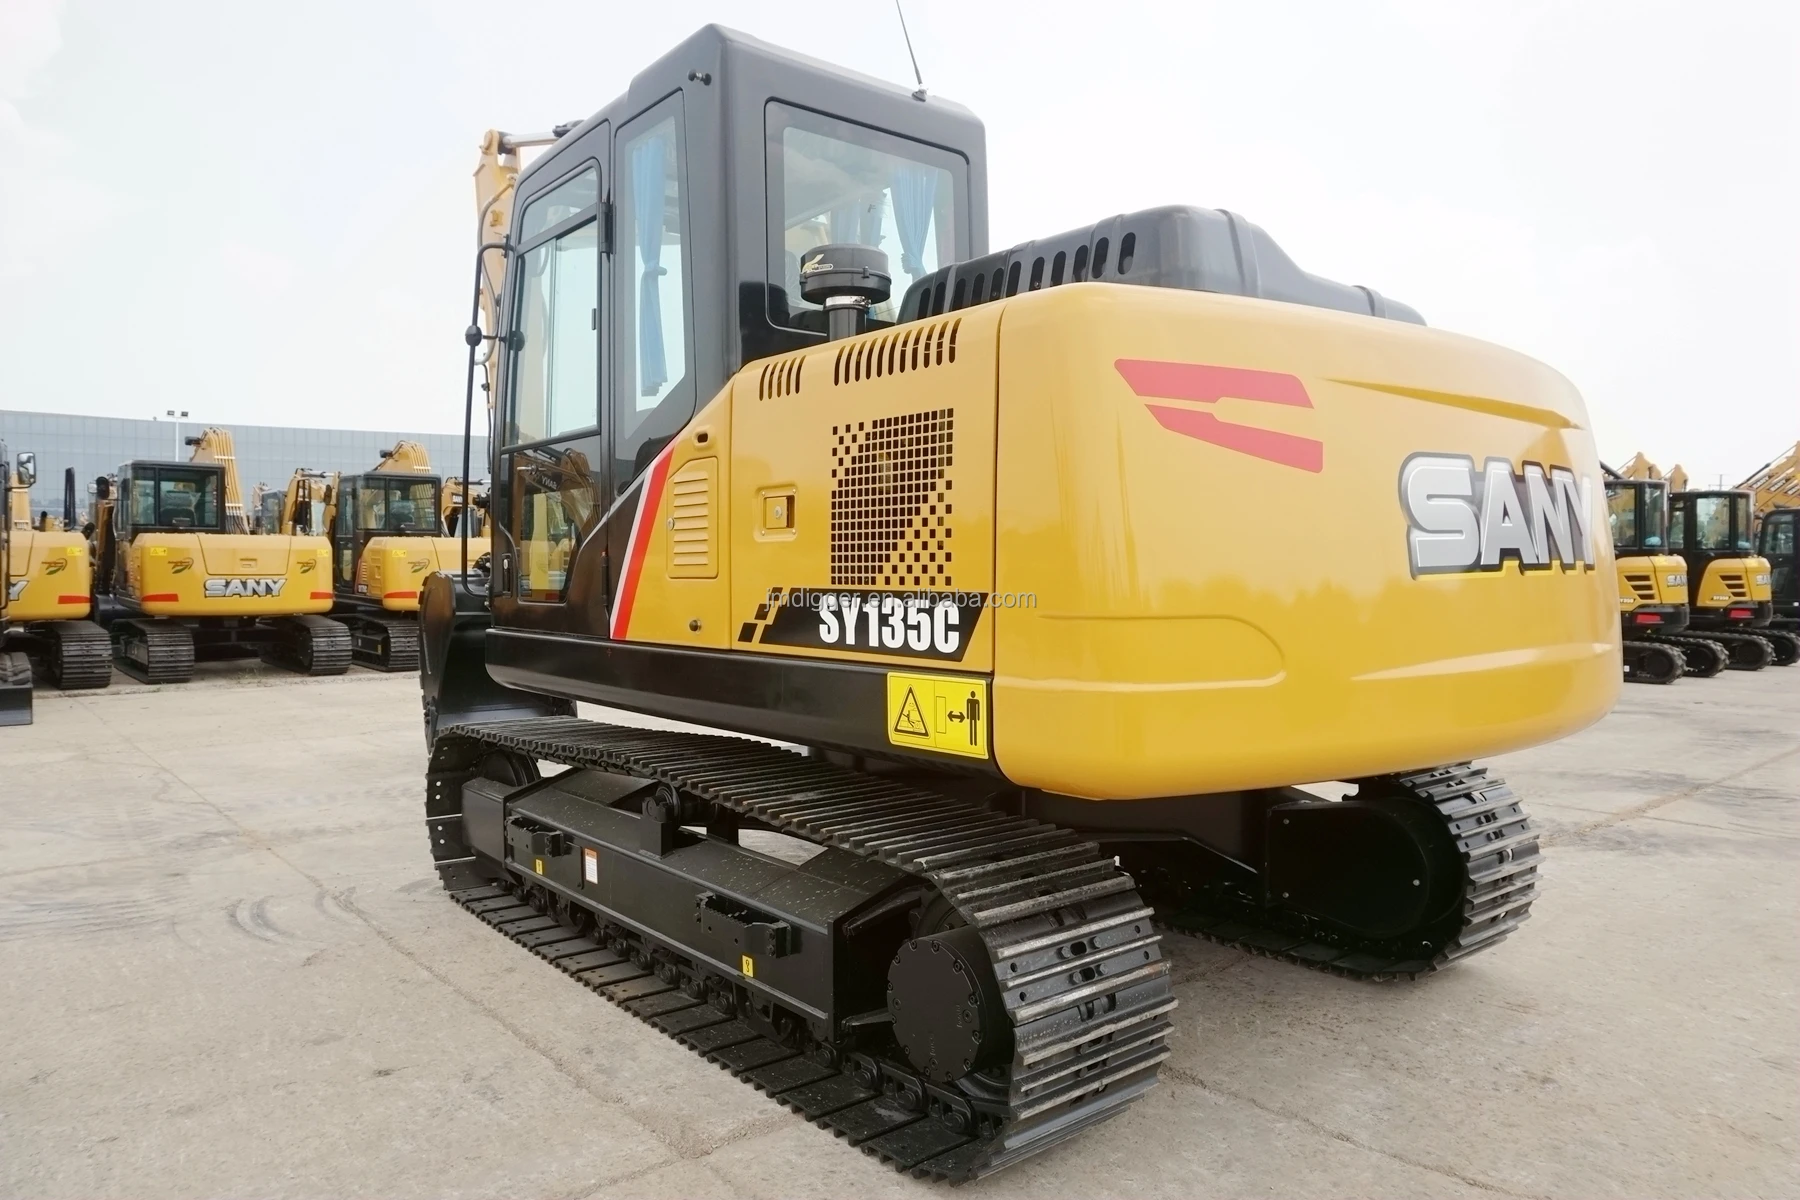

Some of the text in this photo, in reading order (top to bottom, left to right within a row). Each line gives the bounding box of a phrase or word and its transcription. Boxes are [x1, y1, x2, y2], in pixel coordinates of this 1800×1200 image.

[1398, 452, 1596, 580] SANY
[204, 578, 287, 598] SANY
[1667, 574, 1687, 587] SAN
[819, 594, 960, 654] SY135C
